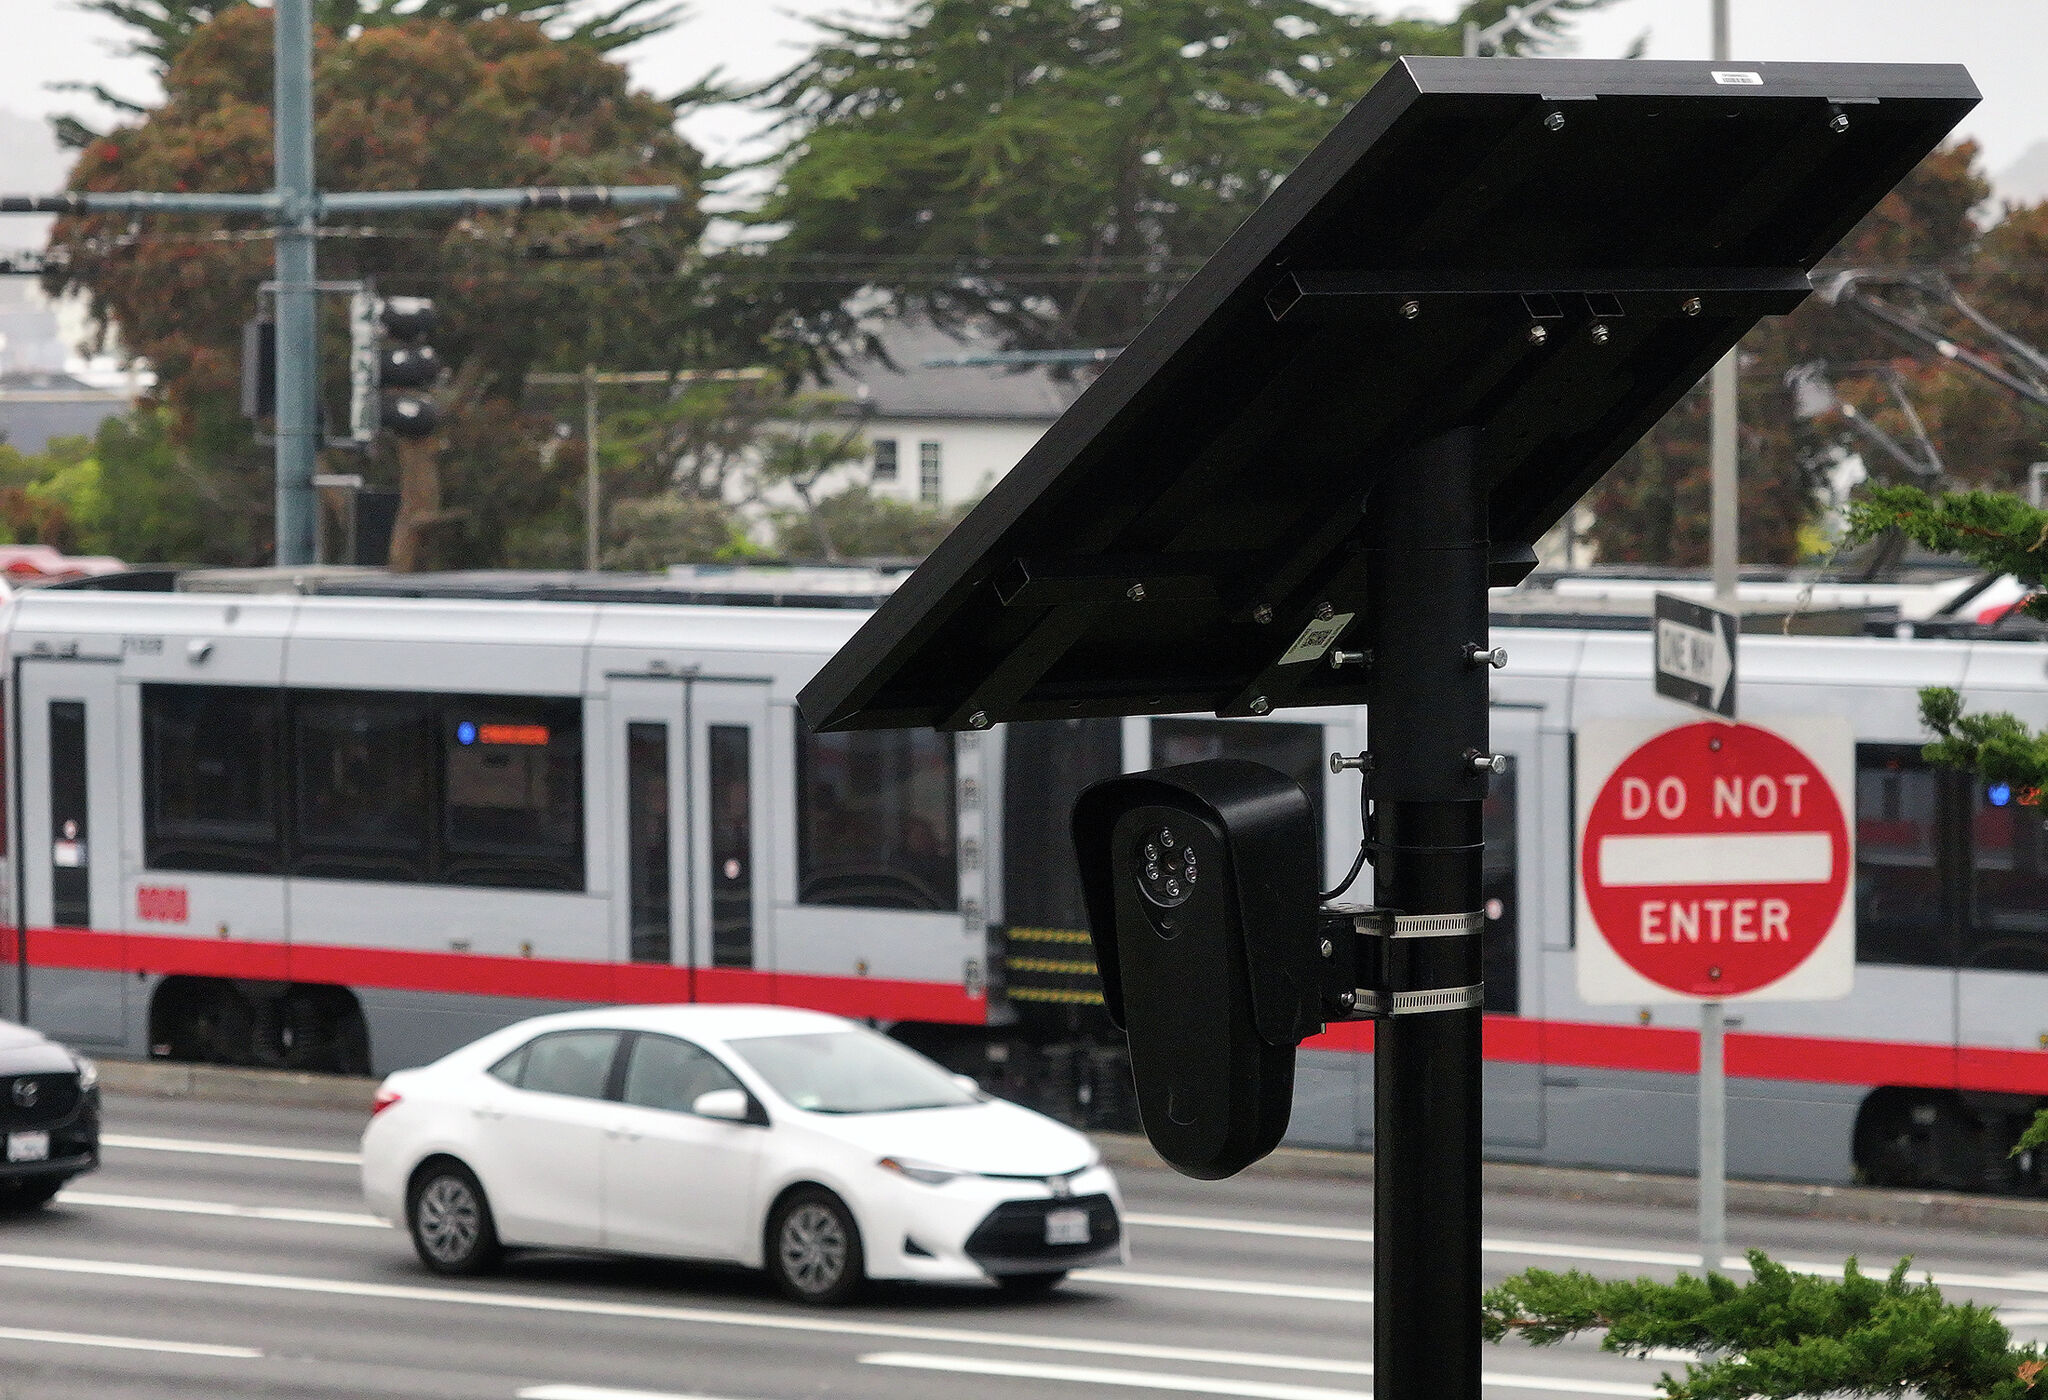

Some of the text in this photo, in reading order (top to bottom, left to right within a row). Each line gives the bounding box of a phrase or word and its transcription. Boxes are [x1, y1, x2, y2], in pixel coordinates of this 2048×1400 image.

[1622, 774, 1808, 820] DO NOT
[1640, 899, 1790, 944] ENTER
